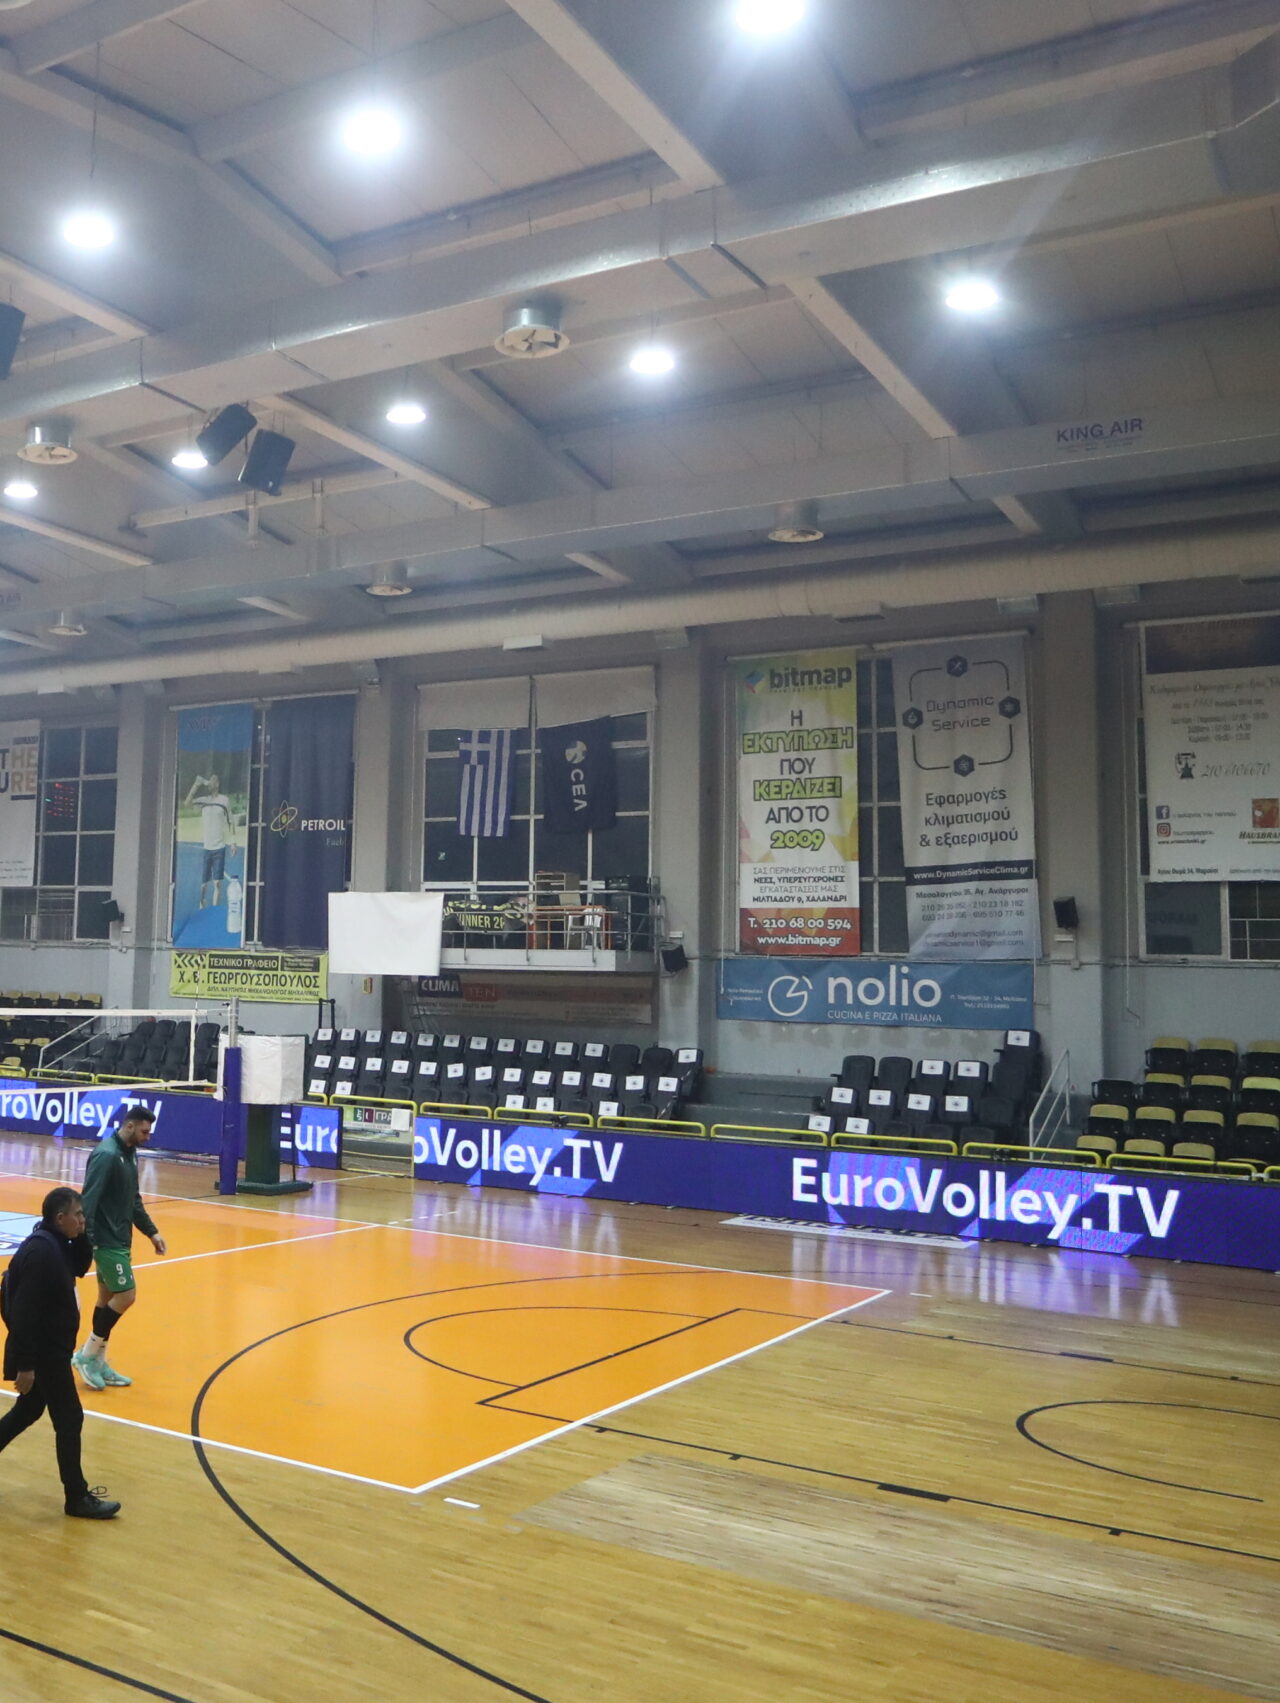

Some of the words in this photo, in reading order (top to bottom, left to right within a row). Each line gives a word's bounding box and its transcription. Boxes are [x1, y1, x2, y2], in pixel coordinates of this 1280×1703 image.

[1056, 423, 1105, 443] KING
[1110, 417, 1143, 437] AIR
[769, 666, 852, 689] bitmap
[925, 695, 995, 714] Dynamic
[790, 709, 803, 727] Η
[931, 715, 992, 732] Service
[742, 726, 854, 755] ΕΚΤΥΠΩΣΗ
[779, 757, 816, 776] ΠΟΥ
[752, 775, 843, 802] ΚΕΡΔΙΖΕΙ
[925, 787, 1008, 808] Εφαρμογές
[764, 806, 804, 825] ΑΠΟ
[805, 805, 830, 823] ΤΟ
[924, 806, 1011, 828] κλιματισμού
[301, 818, 347, 833] PETROIL
[770, 828, 826, 852] 2009
[919, 833, 931, 847] &
[935, 827, 1019, 848] εξαερισμού
[762, 918, 786, 929] 210
[789, 917, 805, 929] 68
[807, 918, 825, 929] 00
[826, 918, 852, 930] 594
[756, 934, 842, 947] www.bitmap.gr
[209, 957, 243, 968] ΤΕΧΝΙΚΟ
[243, 958, 278, 969] ΓΡΑΦΕΙΟ
[207, 971, 320, 989] ΓΕΩΡΓΟΥΣΟΠΟΥΛΟΣ
[421, 979, 460, 992] CLIMA
[827, 964, 942, 1008] nolio
[827, 1010, 863, 1020] CUCINA
[872, 1011, 899, 1021] PIZZA
[899, 1013, 943, 1023] ITALIANA
[791, 1156, 1180, 1240] EuroVolley.TV
[115, 1263, 124, 1276] 9
